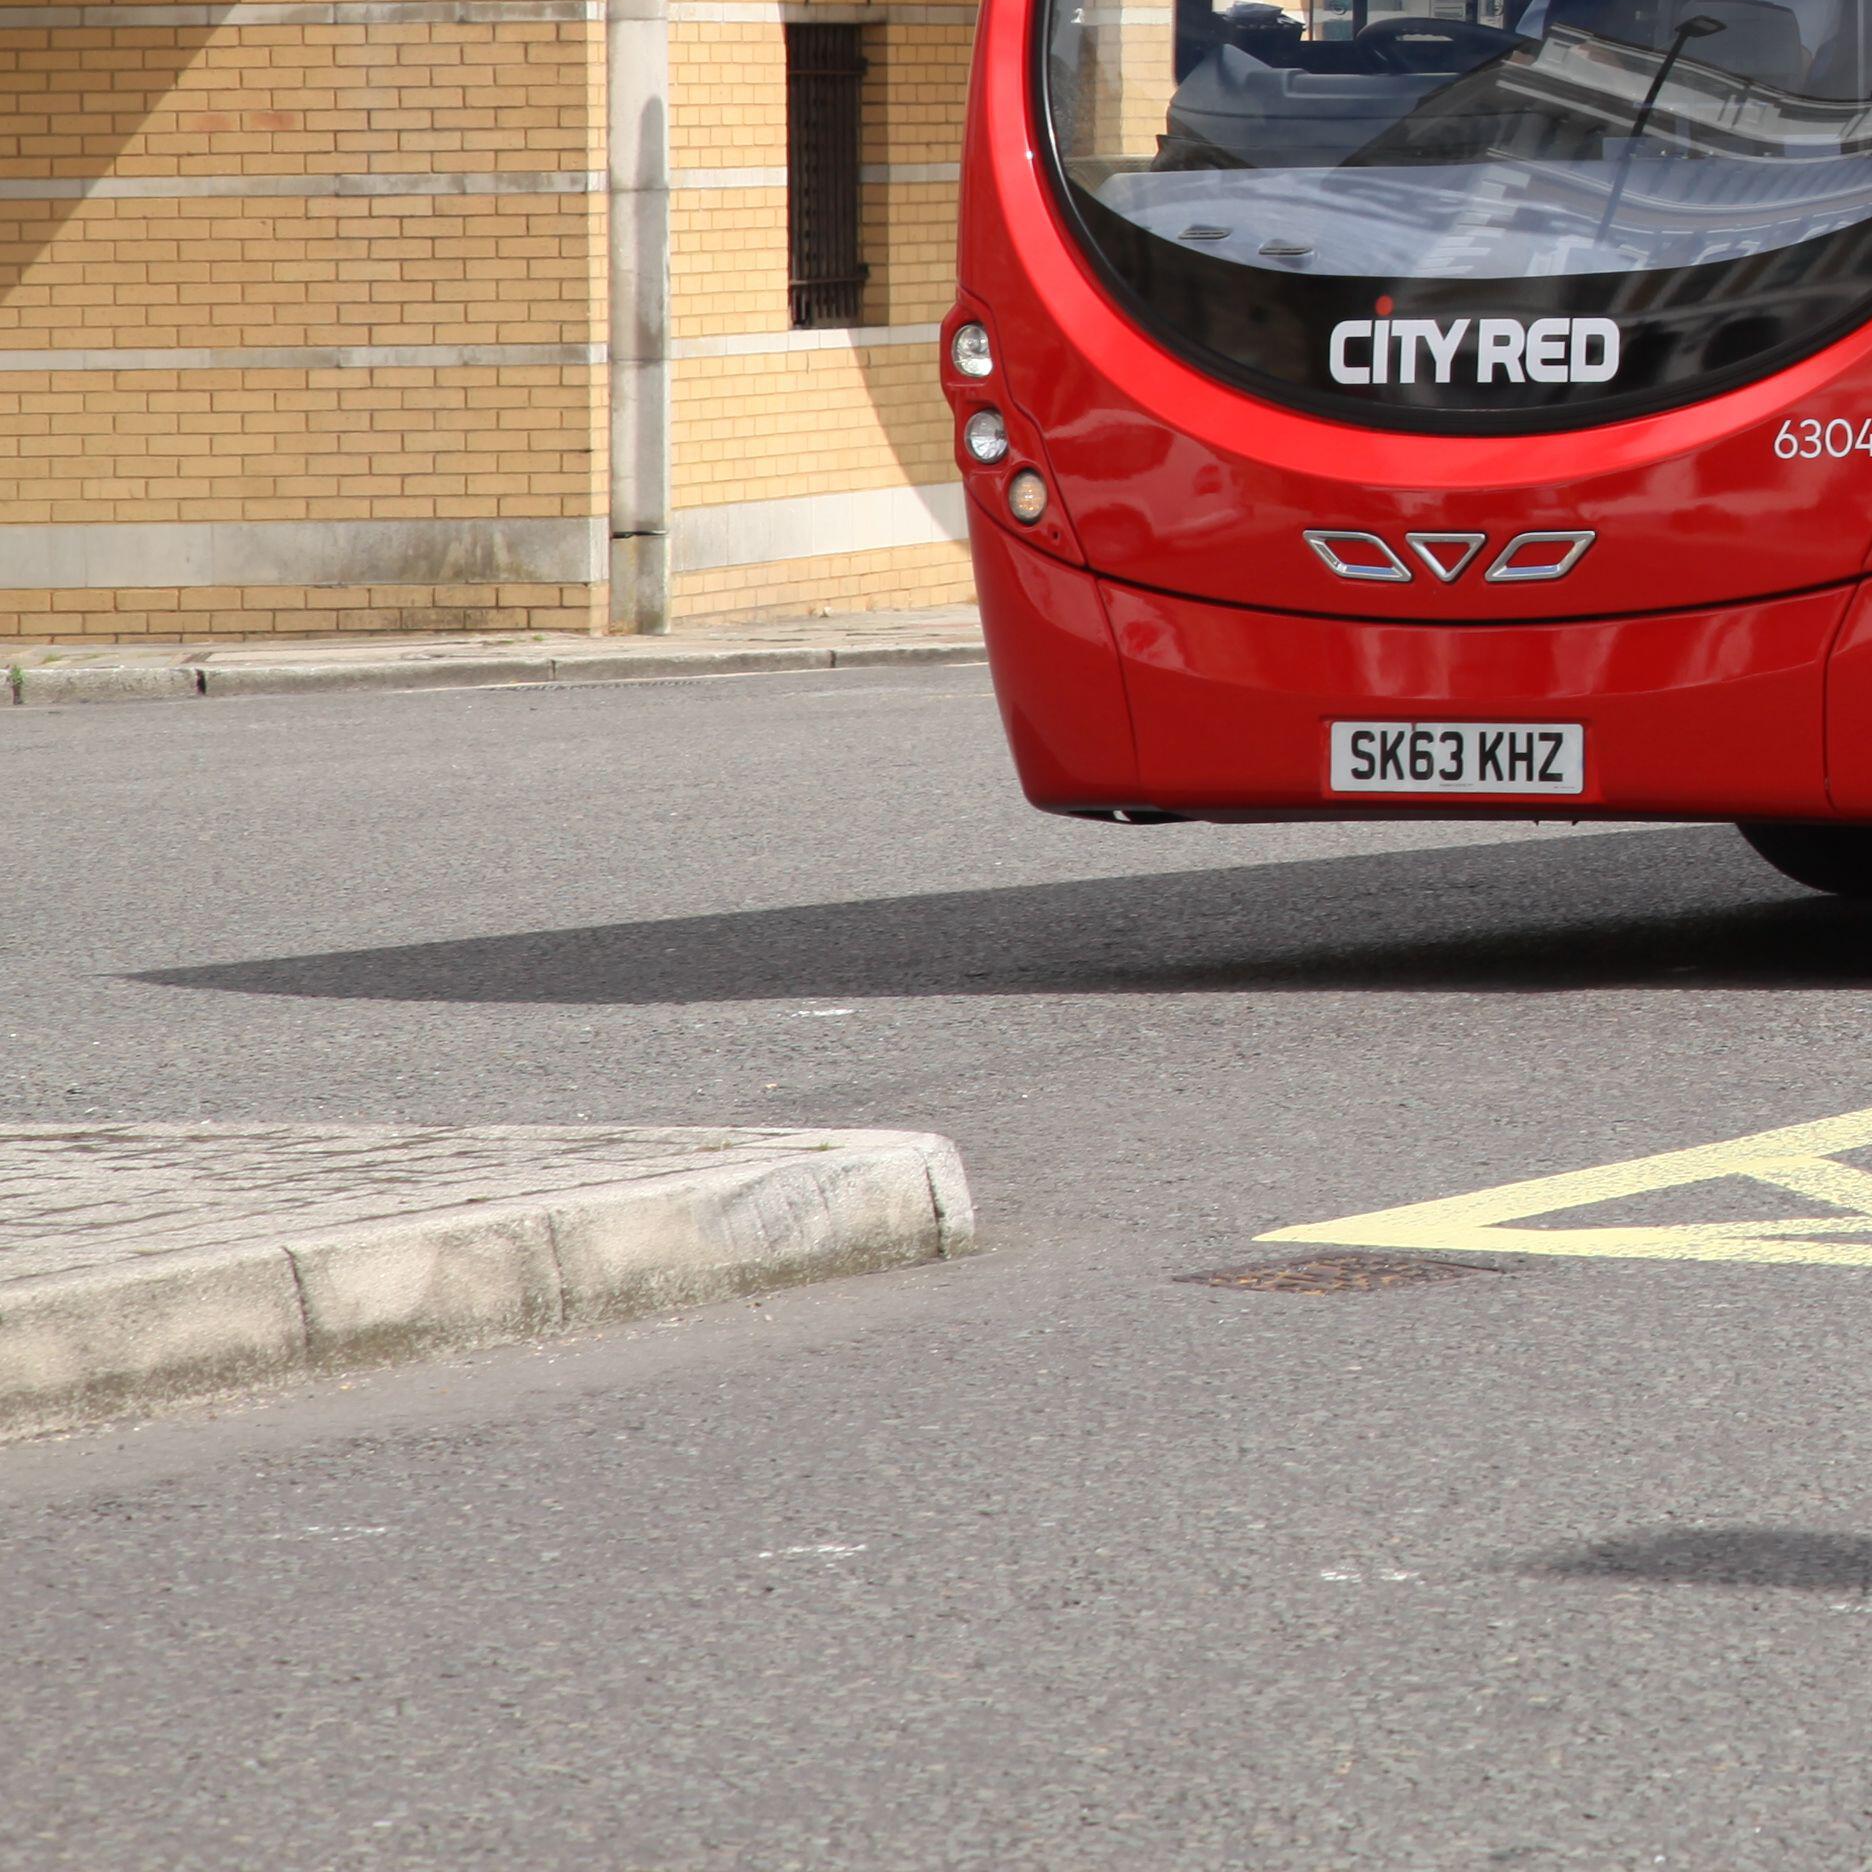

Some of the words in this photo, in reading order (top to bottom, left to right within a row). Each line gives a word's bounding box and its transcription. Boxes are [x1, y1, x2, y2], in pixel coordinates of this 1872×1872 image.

[1477, 318, 1620, 383] RED
[1351, 730, 1464, 781] SK63
[1478, 731, 1564, 782] KHZ
